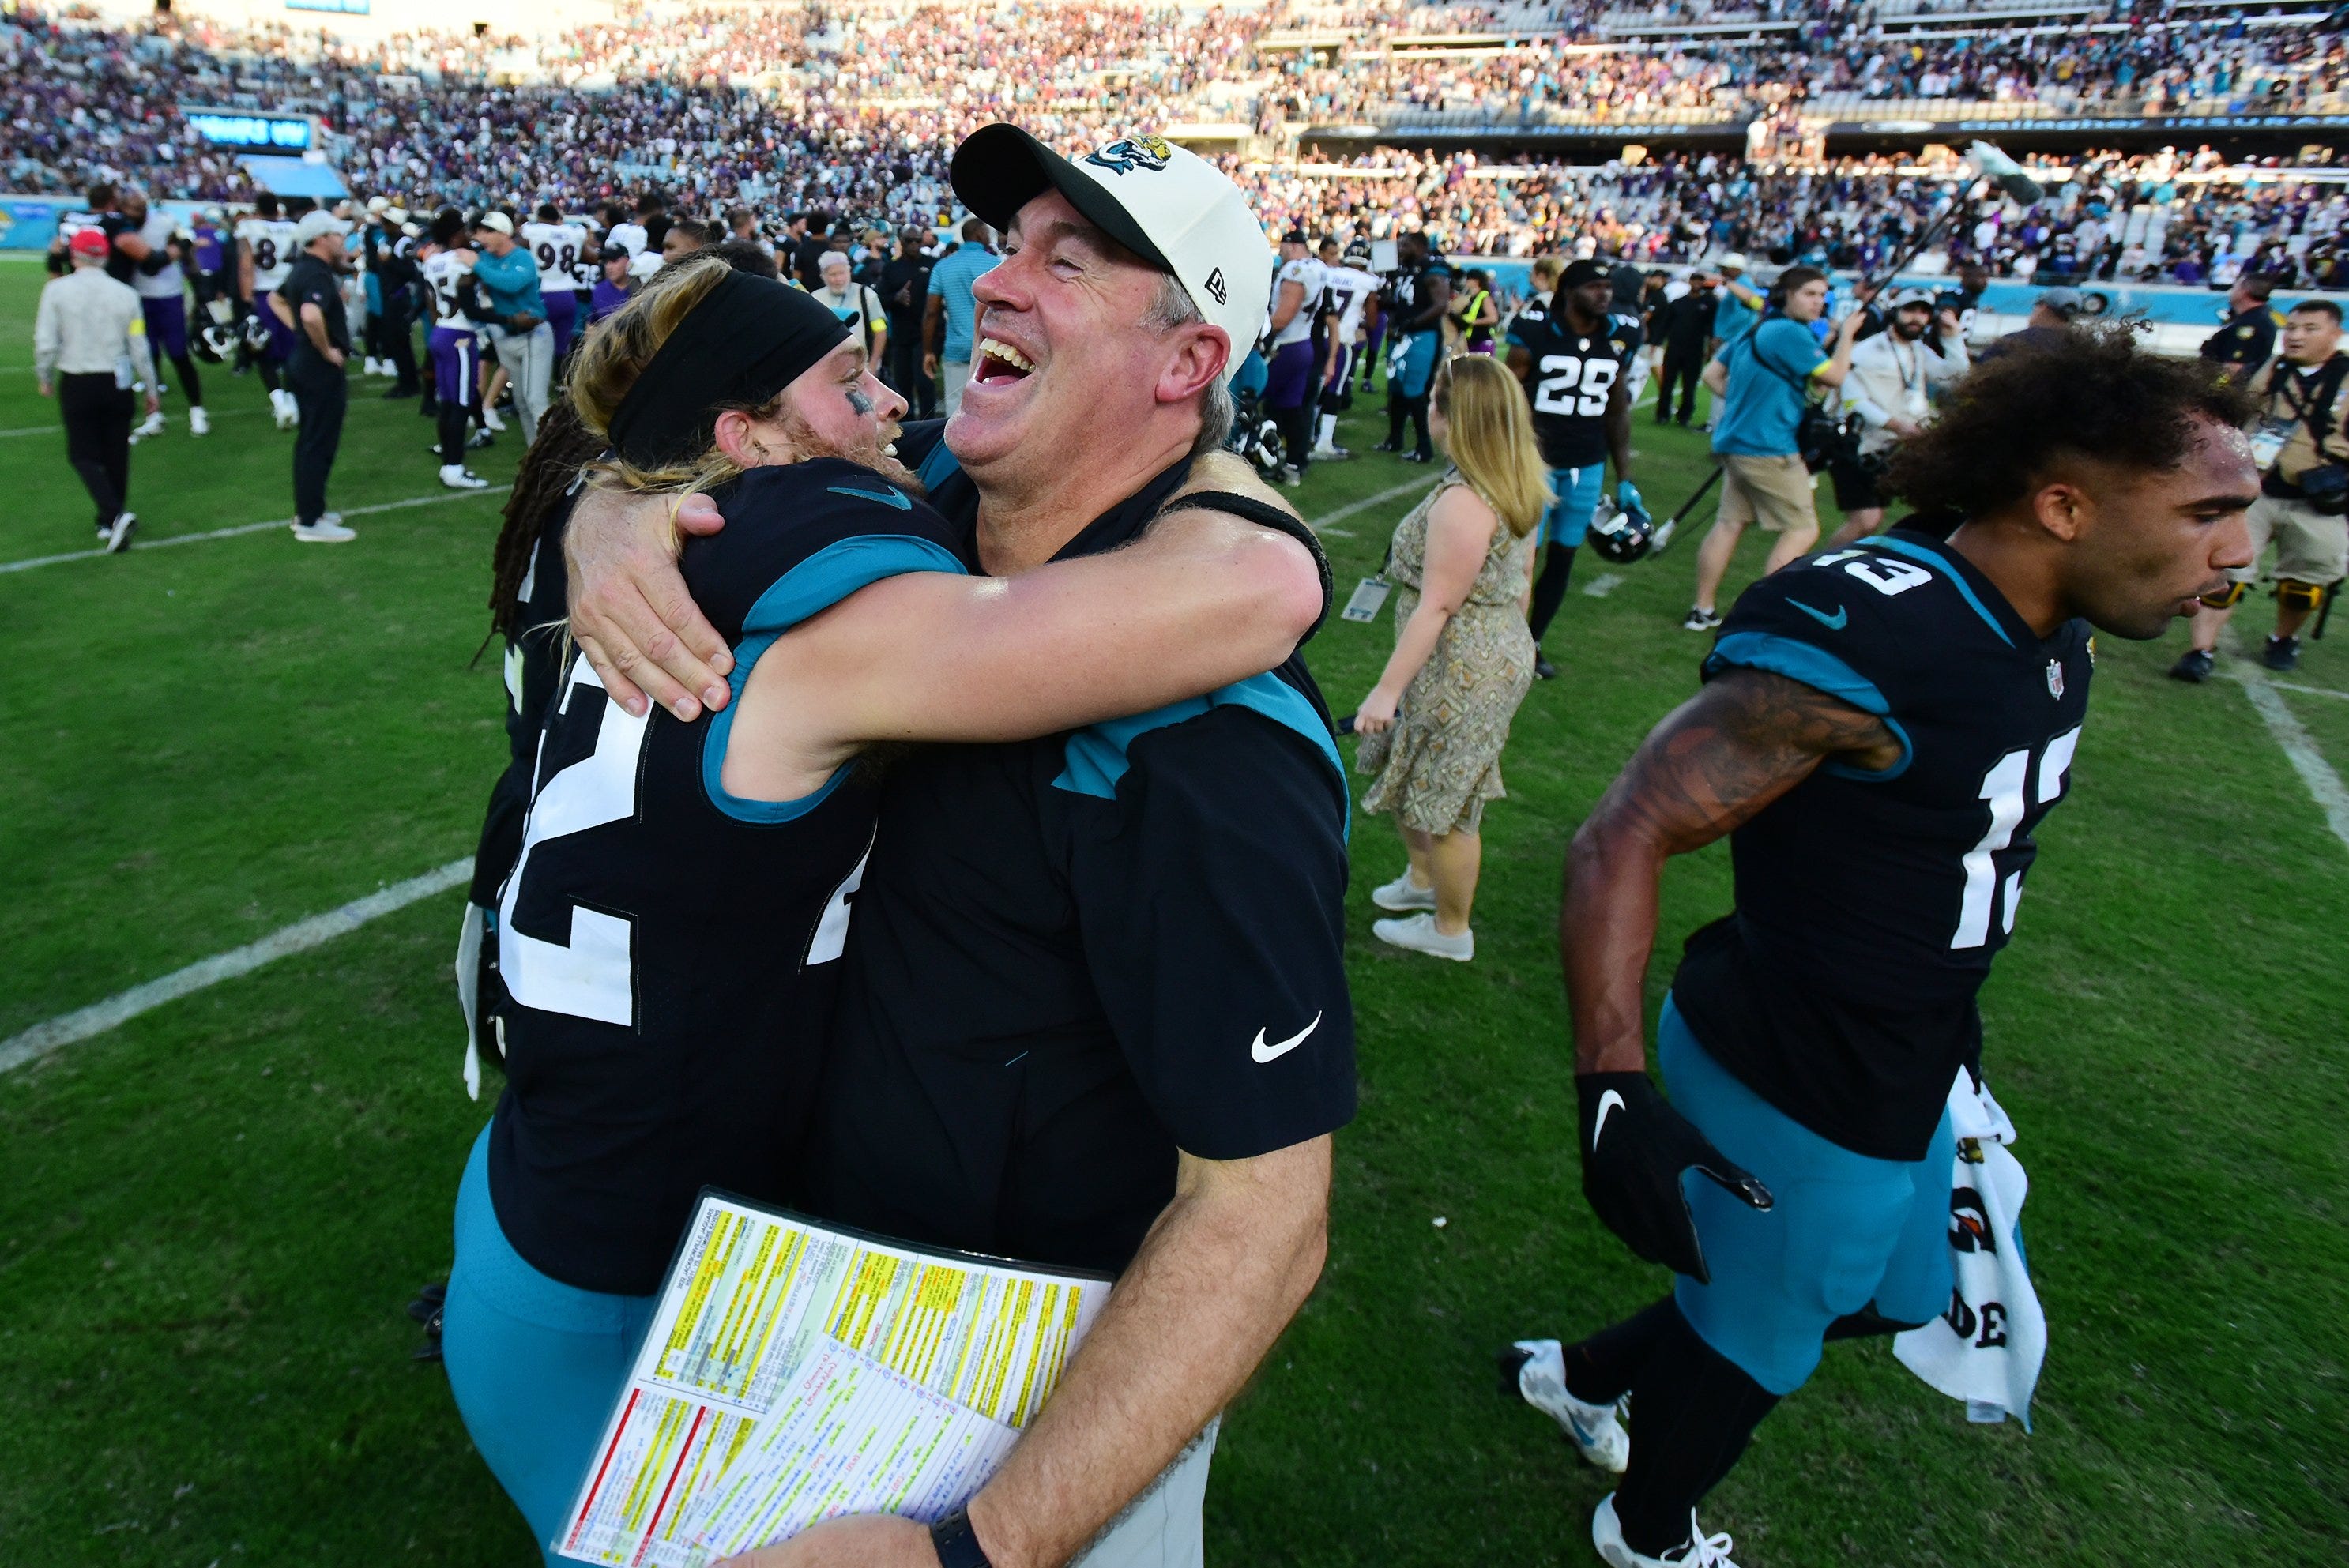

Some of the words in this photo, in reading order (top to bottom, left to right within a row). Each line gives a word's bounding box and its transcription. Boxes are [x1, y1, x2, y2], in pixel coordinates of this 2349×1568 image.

[538, 243, 574, 273] 98
[1534, 355, 1619, 416] 29
[682, 1235, 702, 1275] JACKSONVILLE
[699, 1206, 714, 1234] JAGUARS
[697, 1230, 712, 1258] BALTIMORE
